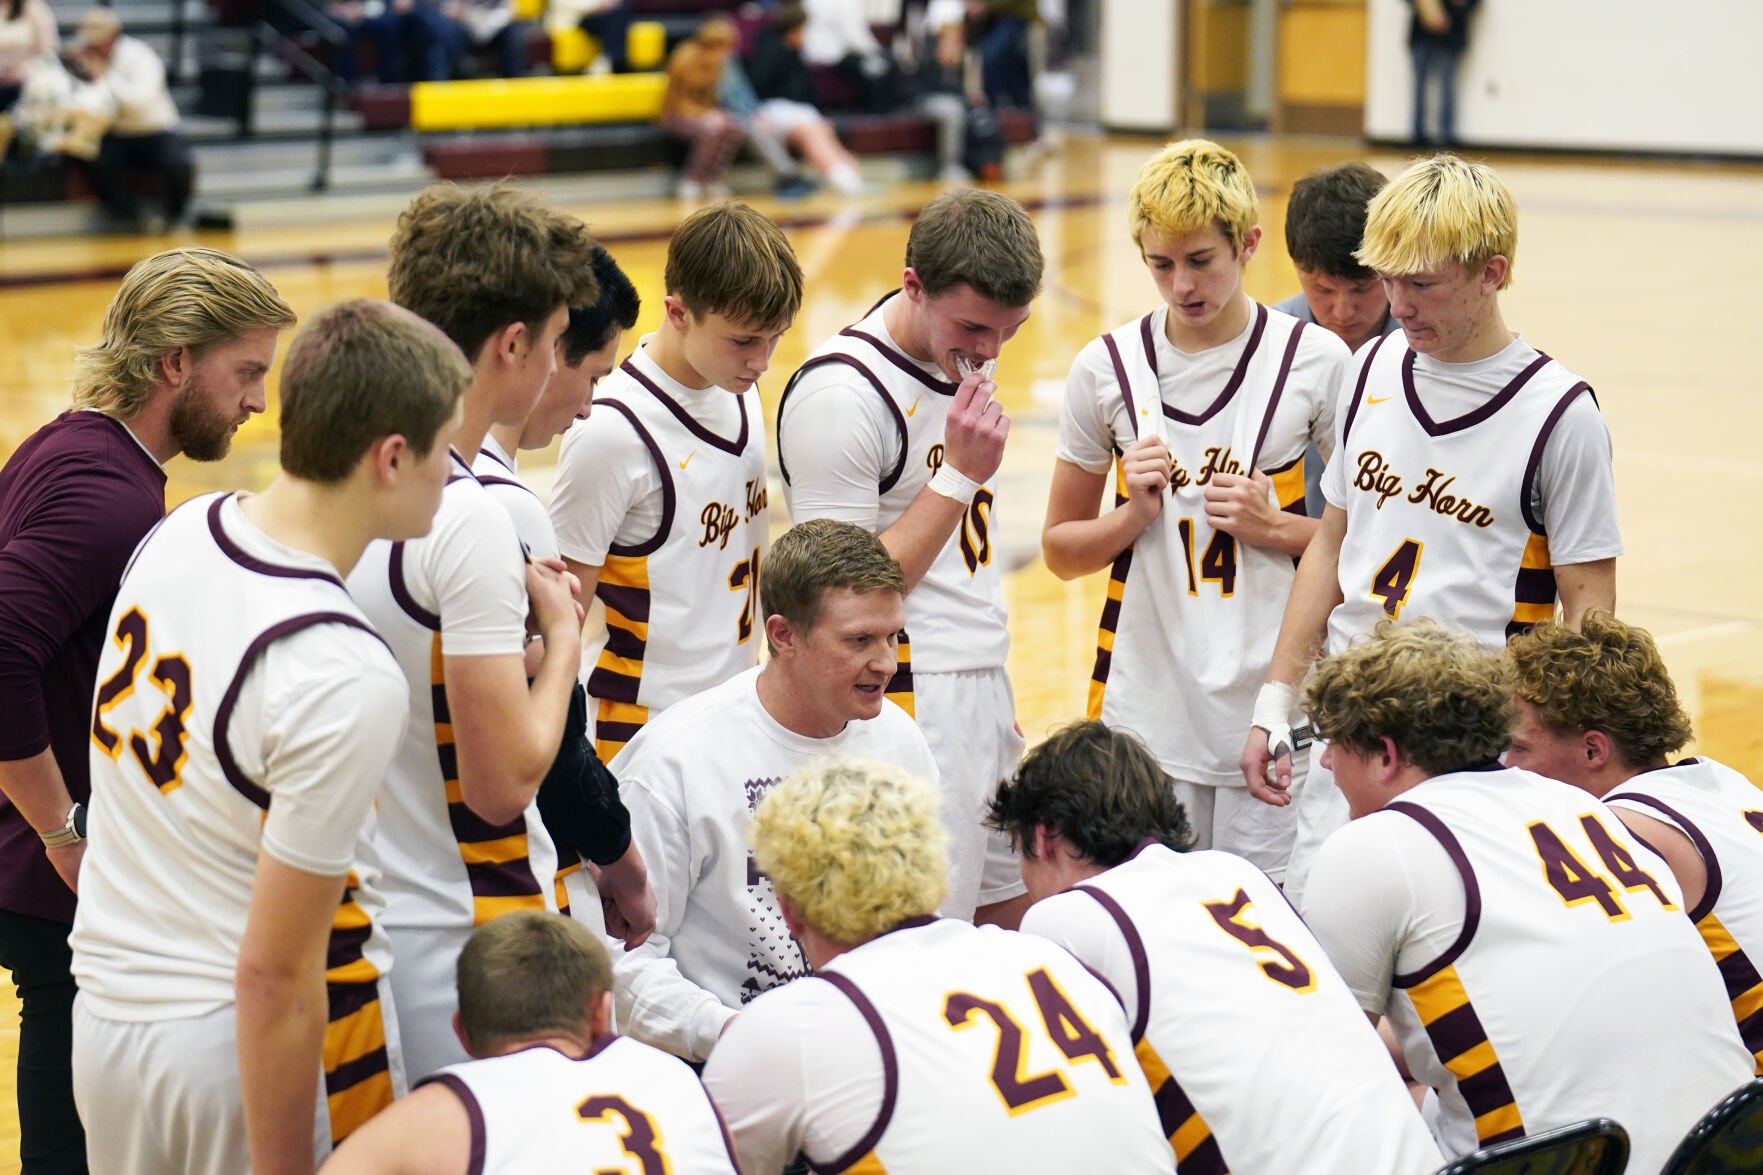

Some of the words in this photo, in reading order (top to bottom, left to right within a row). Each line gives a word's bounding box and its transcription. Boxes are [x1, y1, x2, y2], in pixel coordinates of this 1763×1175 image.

[699, 501, 739, 550] Big
[745, 476, 768, 524] Hor
[1353, 449, 1403, 510] Big
[1407, 467, 1495, 528] Horn
[1178, 516, 1237, 598] 14
[1370, 537, 1424, 620] 4
[91, 603, 194, 796] 23
[1525, 811, 1681, 923] 44
[1200, 886, 1317, 994] 5
[941, 965, 1128, 1117] 24
[573, 1094, 675, 1175] 3
